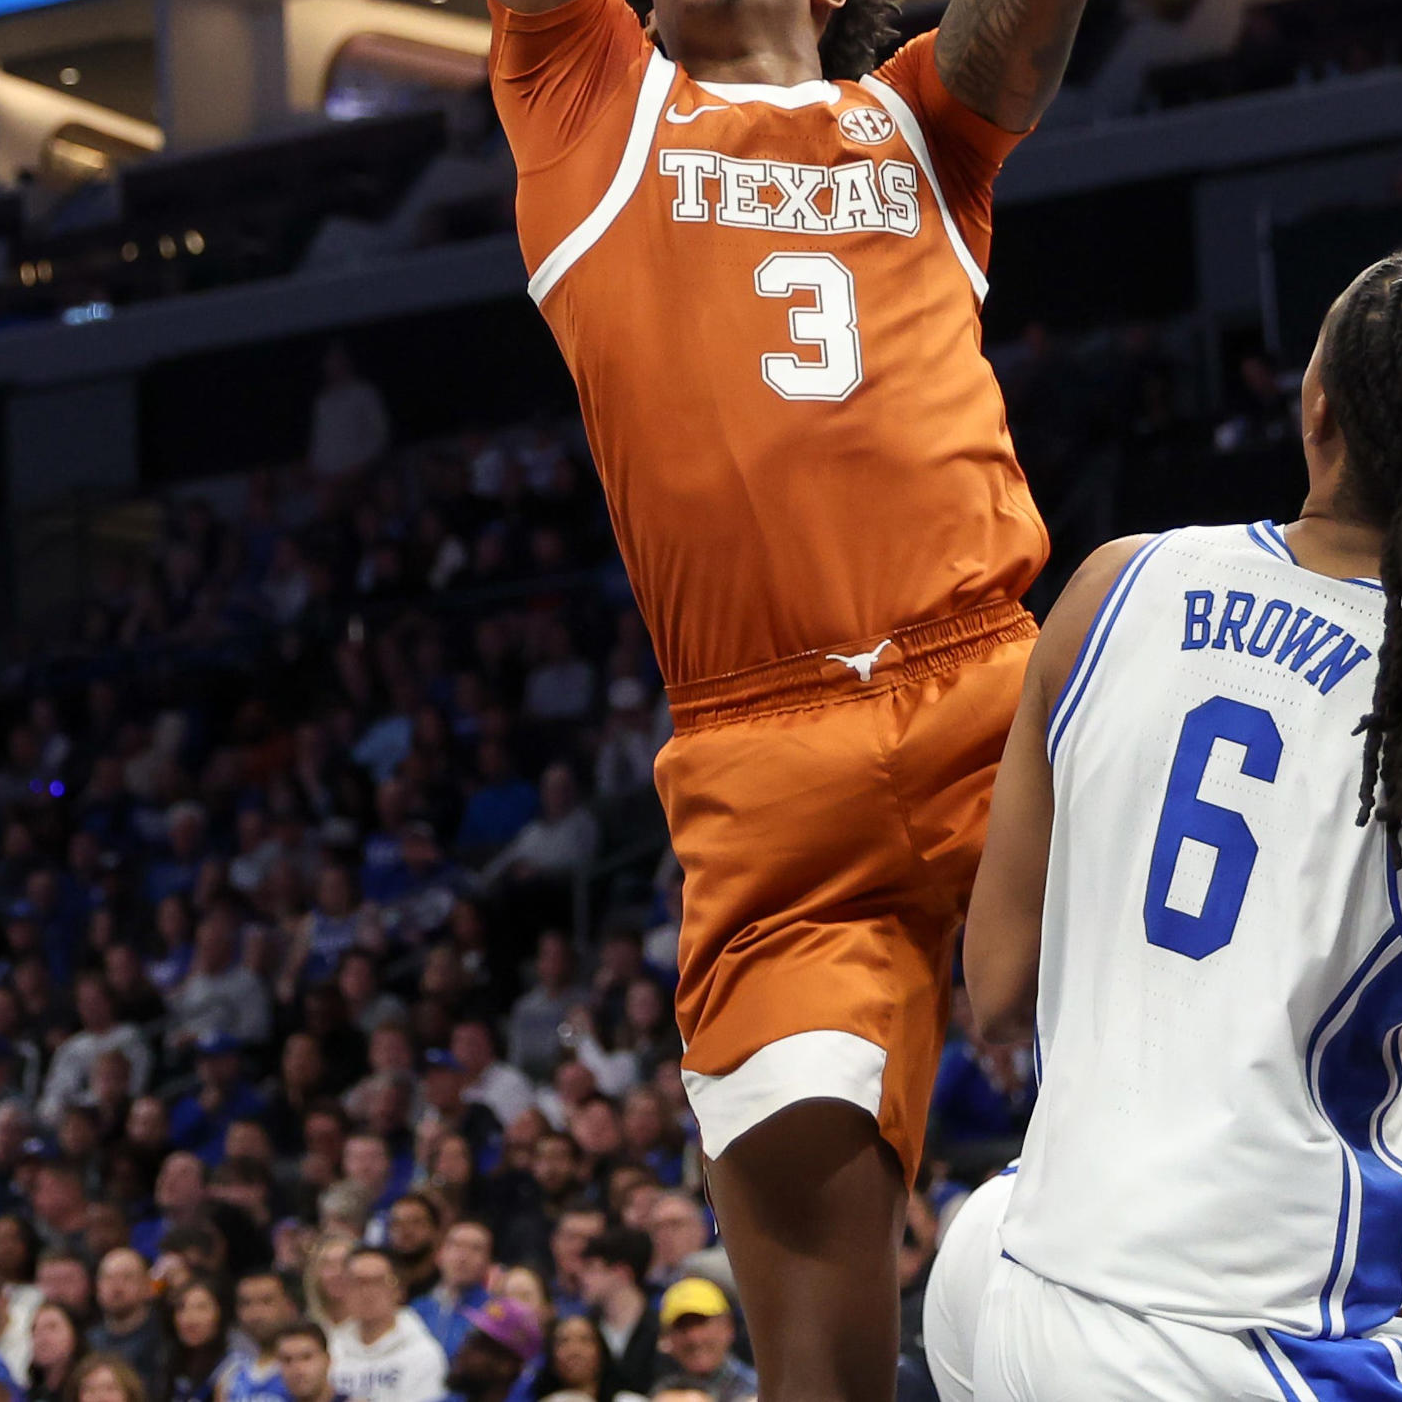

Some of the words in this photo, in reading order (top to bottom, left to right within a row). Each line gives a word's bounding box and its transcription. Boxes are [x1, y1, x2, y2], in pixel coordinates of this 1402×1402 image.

[841, 109, 892, 142] SEC
[659, 148, 921, 238] TEXAS
[754, 251, 863, 402] 3
[1181, 589, 1373, 696] BROWN
[1143, 695, 1284, 961] 6
